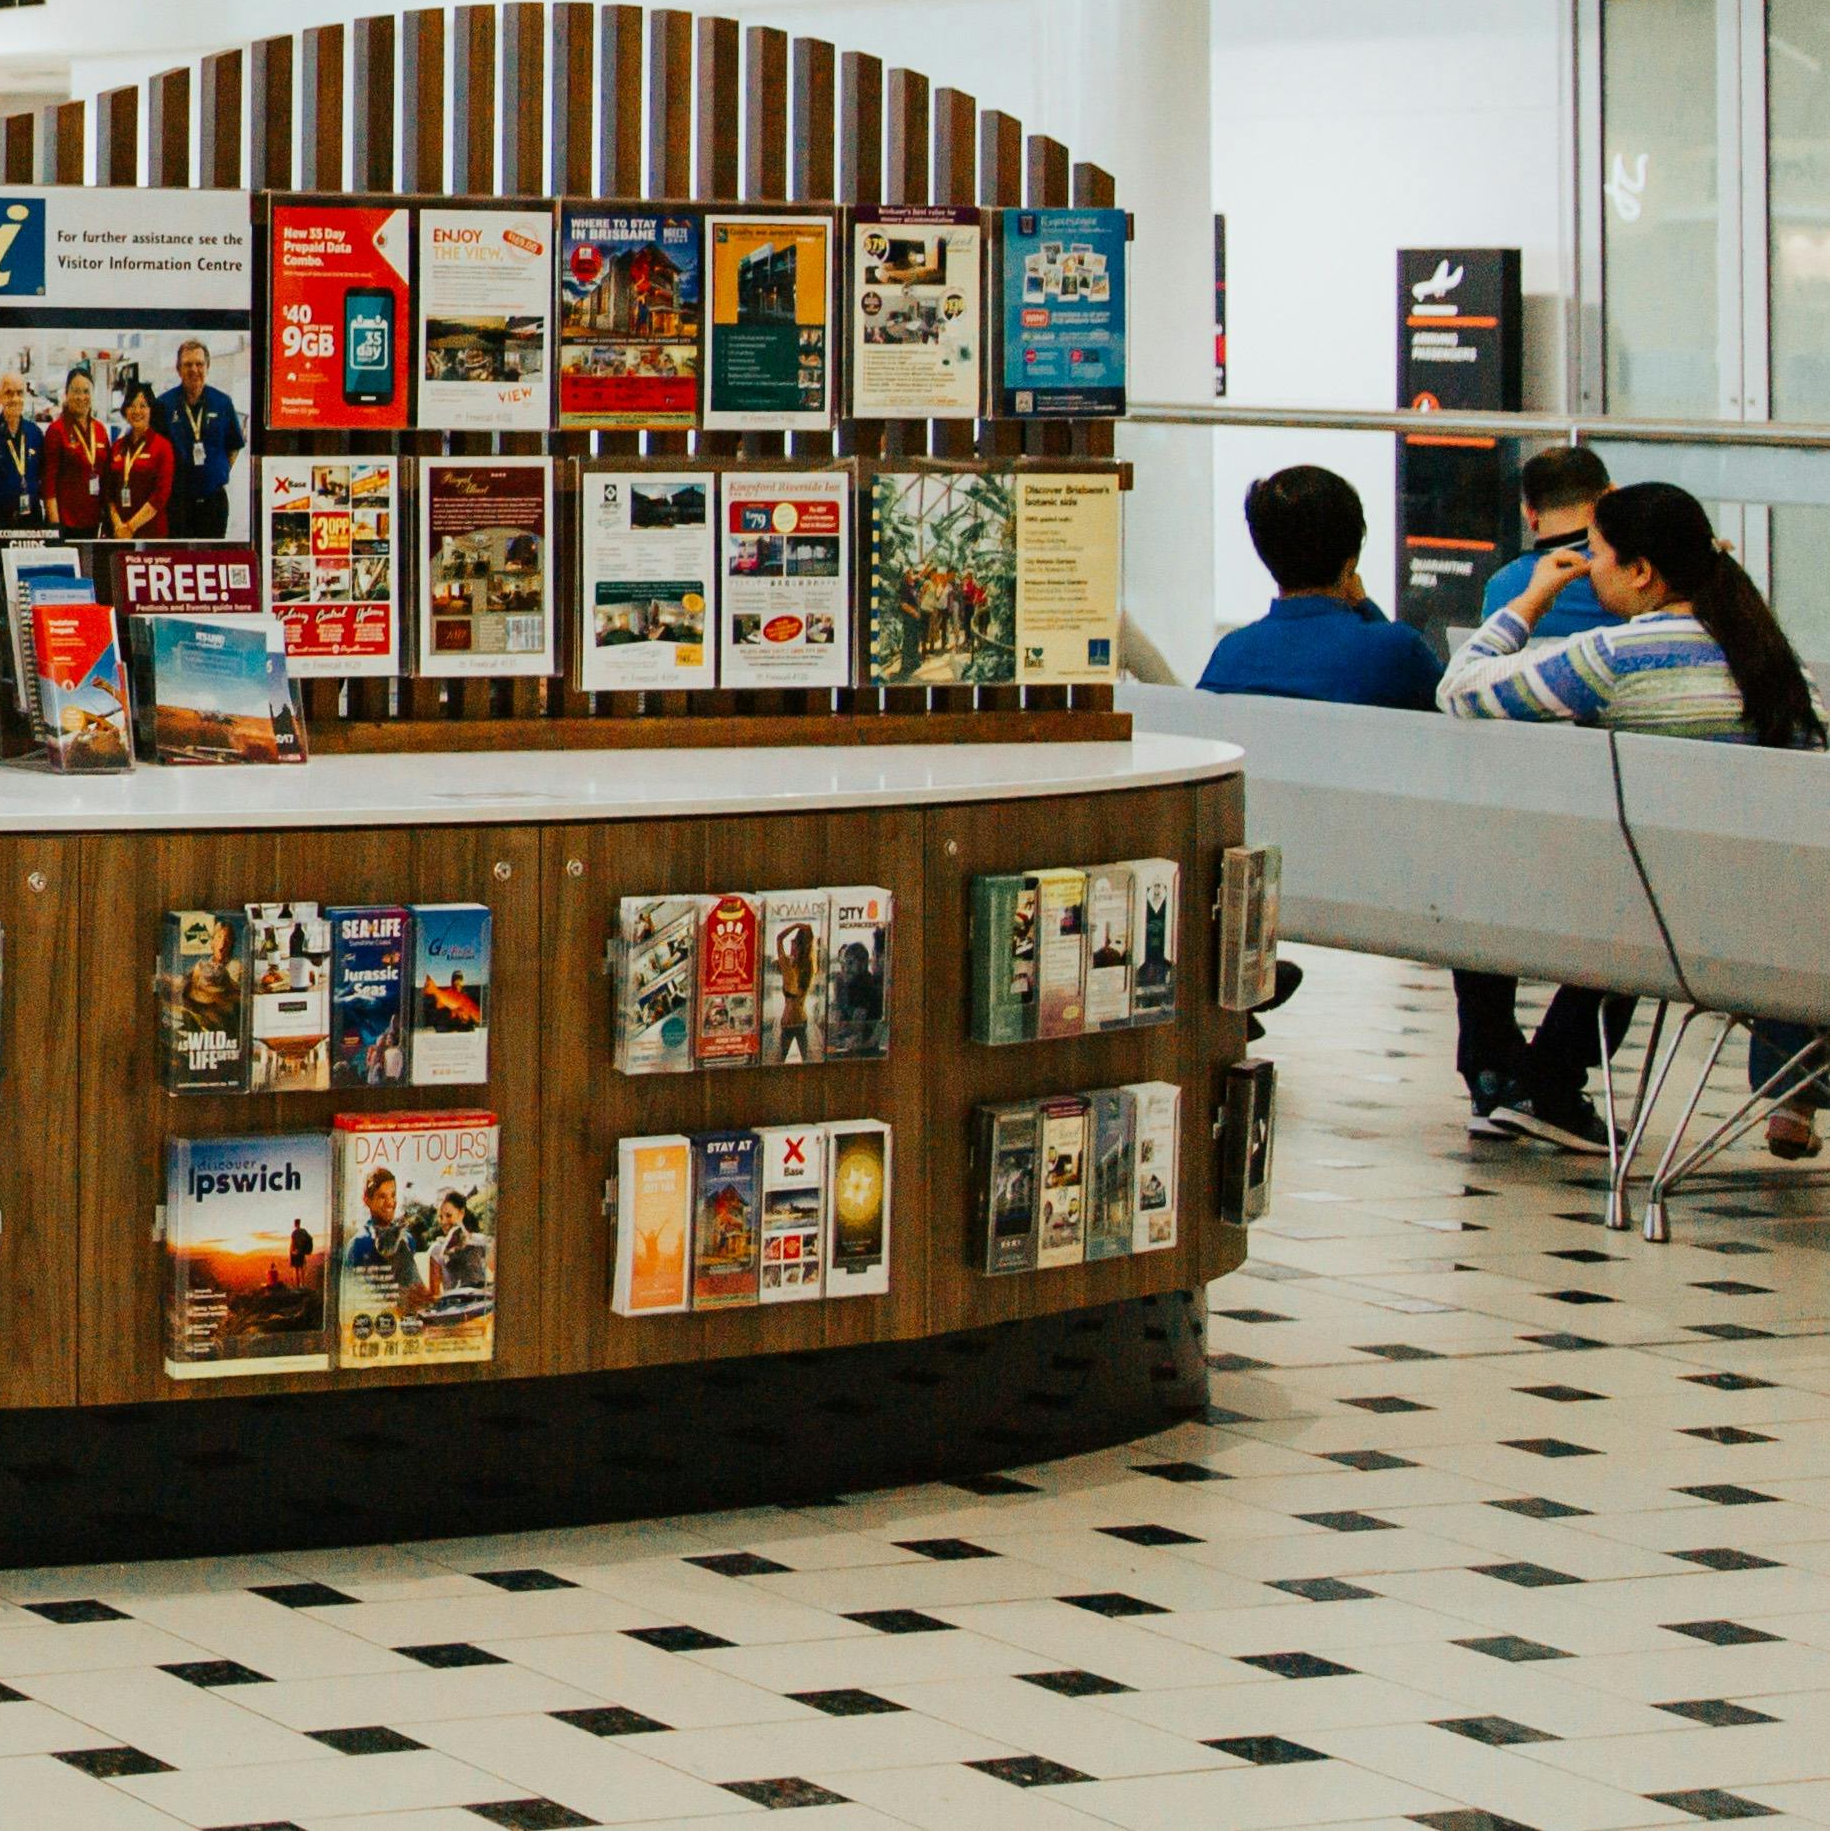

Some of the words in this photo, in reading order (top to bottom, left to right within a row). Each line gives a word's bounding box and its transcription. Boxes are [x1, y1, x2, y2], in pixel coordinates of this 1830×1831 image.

[571, 217, 610, 230] WHERE
[613, 218, 629, 229] TO
[630, 218, 657, 230] STAY
[57, 230, 78, 244] For
[81, 229, 128, 244] further
[132, 231, 194, 246] assistance
[198, 235, 219, 246] see
[223, 233, 244, 246] the
[283, 228, 308, 240] New
[309, 228, 324, 240] 35
[324, 228, 346, 242] Day
[433, 227, 484, 244] ENJOY
[571, 228, 587, 241] IN
[588, 228, 657, 242] BRISBANE
[283, 242, 325, 255] Prepaid
[326, 243, 352, 255] Data
[433, 246, 461, 261] THE
[57, 255, 105, 271] Visitor
[109, 256, 192, 272] Information
[197, 257, 243, 272] Centre
[283, 255, 325, 267] Combo.
[282, 304, 313, 324] $40
[282, 325, 335, 358] 9GB
[364, 330, 382, 346] 35
[356, 344, 382, 360] day
[498, 387, 533, 404] VIEW
[289, 480, 307, 489] Base
[778, 481, 824, 492] Riverside
[825, 481, 842, 491] Inn
[1024, 485, 1063, 495] Discover
[1065, 485, 1110, 495] Brisbane's
[1024, 497, 1058, 506] botanic
[1059, 497, 1078, 506] side
[124, 555, 141, 564] Pick
[154, 556, 172, 564] your
[125, 563, 230, 602] FREE!
[170, 604, 185, 612] and
[186, 604, 212, 612] Events
[212, 604, 234, 613] guide
[234, 604, 253, 612] here
[839, 906, 865, 921] CITY
[341, 920, 369, 941] SEA
[343, 967, 400, 983] Jurassic
[353, 982, 388, 999] Seas
[188, 1030, 227, 1052] WILD
[189, 1049, 218, 1070] LIFE
[354, 1135, 407, 1164] DAY
[411, 1130, 489, 1162] TOURS
[707, 1141, 736, 1155] STAY
[737, 1139, 753, 1152] AT
[782, 1166, 805, 1178] Base
[188, 1162, 302, 1203] Ipswich
